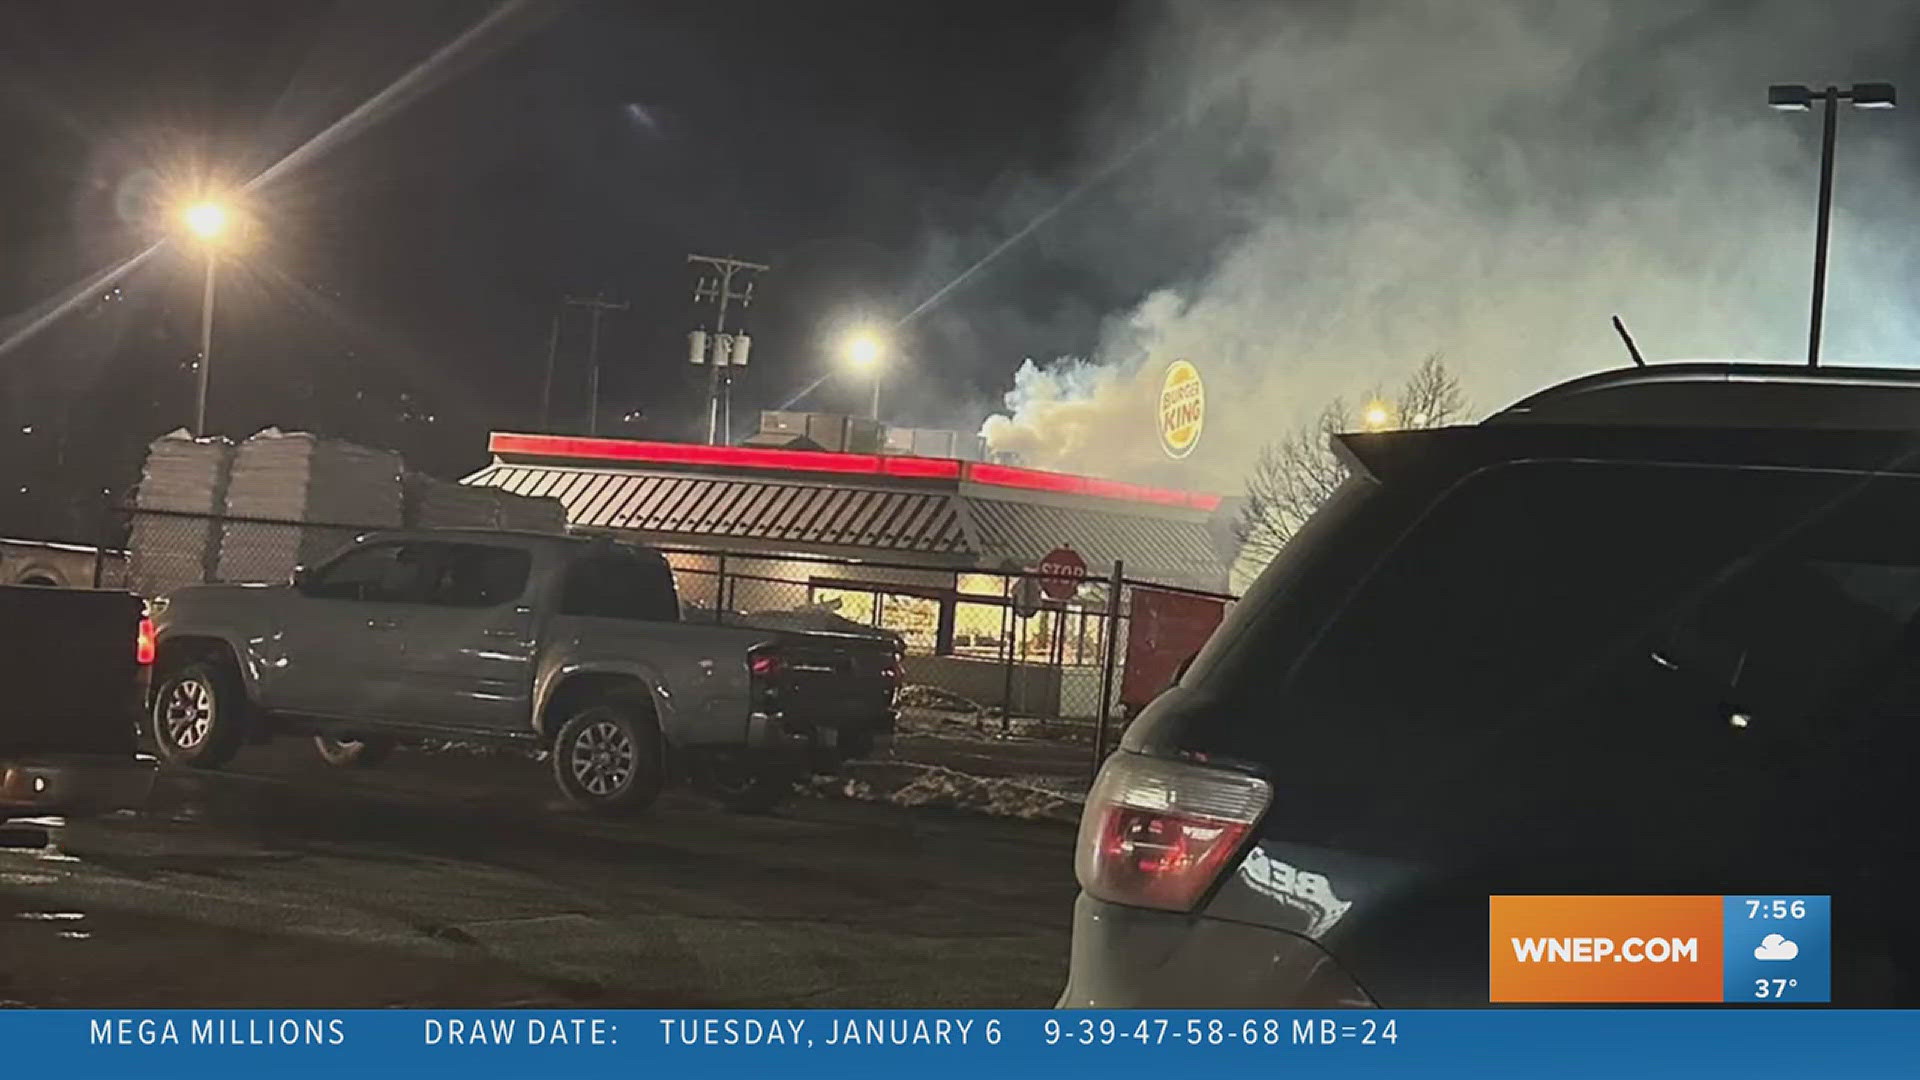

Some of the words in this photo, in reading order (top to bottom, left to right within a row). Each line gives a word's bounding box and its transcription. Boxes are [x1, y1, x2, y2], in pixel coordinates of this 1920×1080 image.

[1163, 381, 1200, 411] BURGER
[1164, 400, 1201, 432] KING
[1041, 562, 1084, 585] STOP
